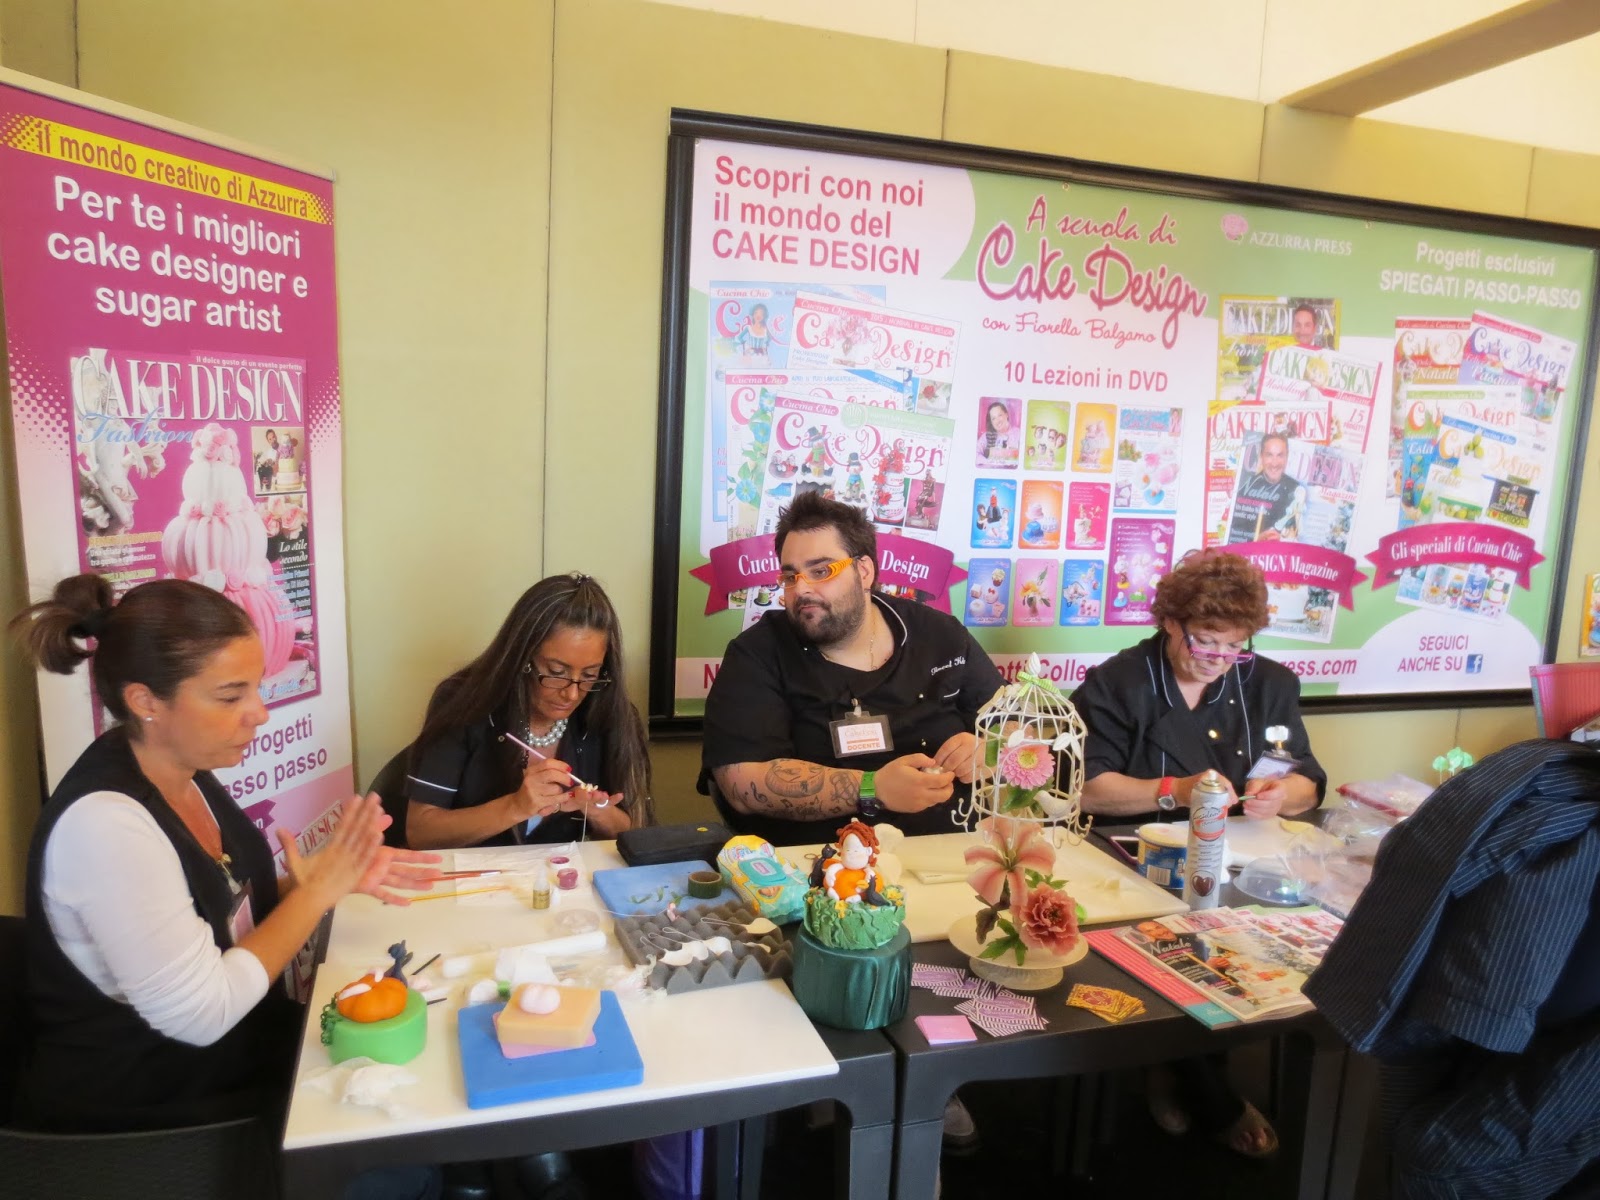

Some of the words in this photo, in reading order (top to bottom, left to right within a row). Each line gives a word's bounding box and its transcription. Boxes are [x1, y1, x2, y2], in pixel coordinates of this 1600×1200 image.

[36, 122, 51, 154] il
[60, 135, 137, 174] mondo
[144, 158, 220, 196] creativo
[227, 175, 242, 202] di
[248, 181, 308, 218] Azzurra
[715, 155, 811, 199] Scopri
[820, 174, 872, 201] con
[881, 179, 924, 207] noi
[54, 175, 122, 222] Per
[131, 193, 166, 232] te
[176, 203, 184, 236] i
[194, 213, 301, 259] migliori
[713, 192, 730, 222] il
[740, 203, 841, 233] mondo
[850, 208, 892, 239] del
[1027, 195, 1047, 232] A
[1057, 206, 1140, 240] scuola
[1149, 214, 1177, 245] di
[712, 228, 799, 265] CAKE
[809, 237, 920, 276] DESIGN
[1250, 232, 1311, 252] AZZURRA
[1314, 237, 1352, 257] PRESS
[1416, 241, 1480, 271] Progetti
[1485, 251, 1556, 277] esclusivi
[47, 231, 141, 272] cake
[151, 243, 286, 295] designer
[292, 276, 308, 298] e
[717, 288, 748, 297] Cucina
[750, 288, 769, 298] Chic
[977, 223, 1077, 304] Cake
[1085, 243, 1207, 350] Design
[1380, 269, 1460, 298] SPIEGATI
[1464, 276, 1581, 310] PASSO-PASSO
[95, 286, 197, 328] sugar
[205, 299, 283, 334] artist
[801, 300, 830, 313] Cucina
[982, 315, 1010, 332] con
[1015, 312, 1081, 337] Fiorella
[1084, 318, 1156, 349] Balzamo
[868, 325, 951, 375] Design
[1517, 340, 1566, 378] Design
[73, 355, 186, 420] CAKE
[188, 363, 303, 424] DESIGN
[731, 375, 763, 384] Cucina
[764, 375, 785, 385] Chic
[1004, 361, 1025, 383] 10
[1032, 362, 1101, 388] Lezioni
[1106, 368, 1122, 389] in
[1128, 369, 1168, 392] DVD
[1327, 361, 1376, 397] ESIGN
[782, 397, 813, 411] Cucina
[815, 404, 836, 416] Chic
[1349, 408, 1365, 424] 15
[77, 406, 194, 444] Fashion
[1212, 411, 1261, 440] CAKE
[1238, 475, 1281, 501] Natale
[1320, 487, 1357, 501] Magazine
[280, 551, 308, 565] secondo
[738, 550, 781, 577] Cuci
[880, 549, 930, 583] Design
[1390, 540, 1408, 561] Gli
[1410, 536, 1452, 561] speciali
[1454, 536, 1466, 550] di
[1467, 536, 1500, 556] Cucina
[1501, 541, 1523, 564] Chic
[1249, 555, 1287, 572] ESIGN
[1288, 555, 1339, 582] Magazine
[1418, 634, 1469, 652] SEGUICI
[1037, 658, 1099, 682] Colle
[1397, 656, 1441, 673] ANCHE
[1444, 655, 1463, 672] SU
[240, 713, 313, 768] progetti
[847, 742, 881, 751] DOCENTE
[274, 748, 328, 789] passo
